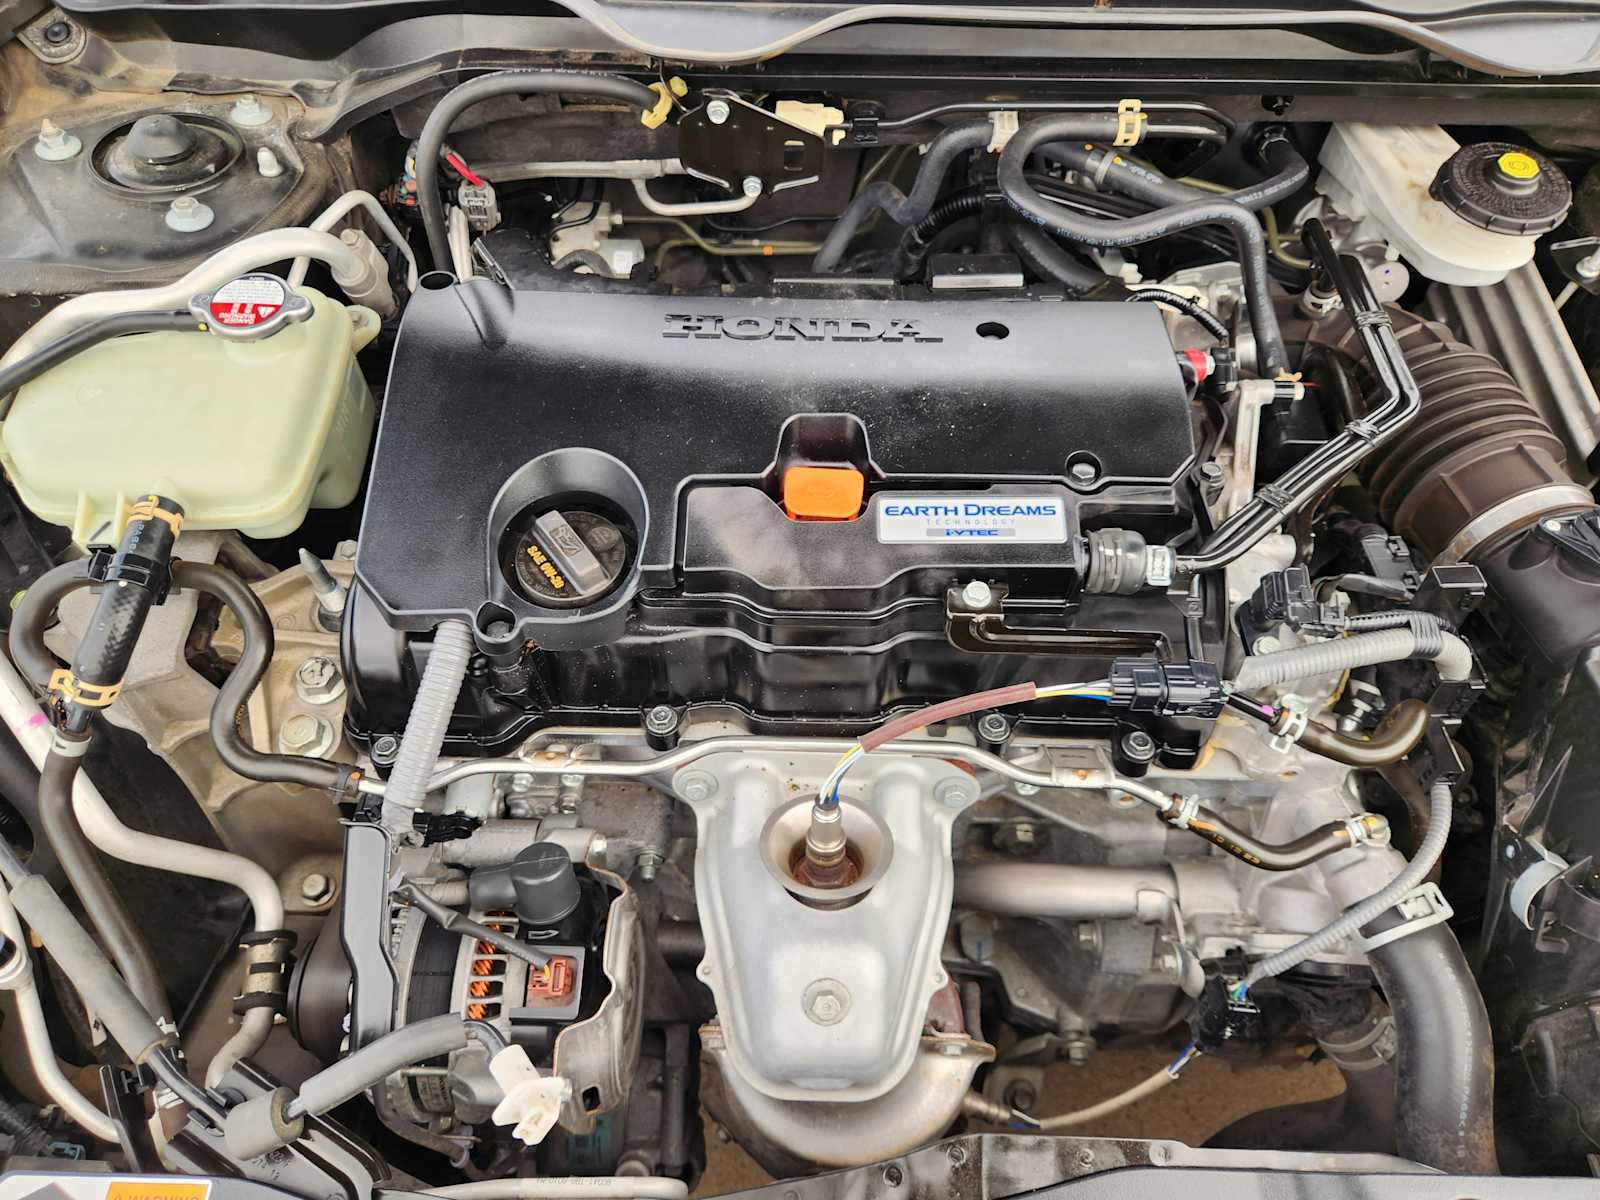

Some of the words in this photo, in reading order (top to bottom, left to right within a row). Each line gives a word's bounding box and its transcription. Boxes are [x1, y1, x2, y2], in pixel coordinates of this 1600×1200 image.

[662, 314, 943, 342] HONDA
[884, 505, 959, 516] EARTH
[964, 504, 1057, 516] DREAMS
[527, 545, 547, 566] SAE
[540, 562, 565, 589] 0W-20
